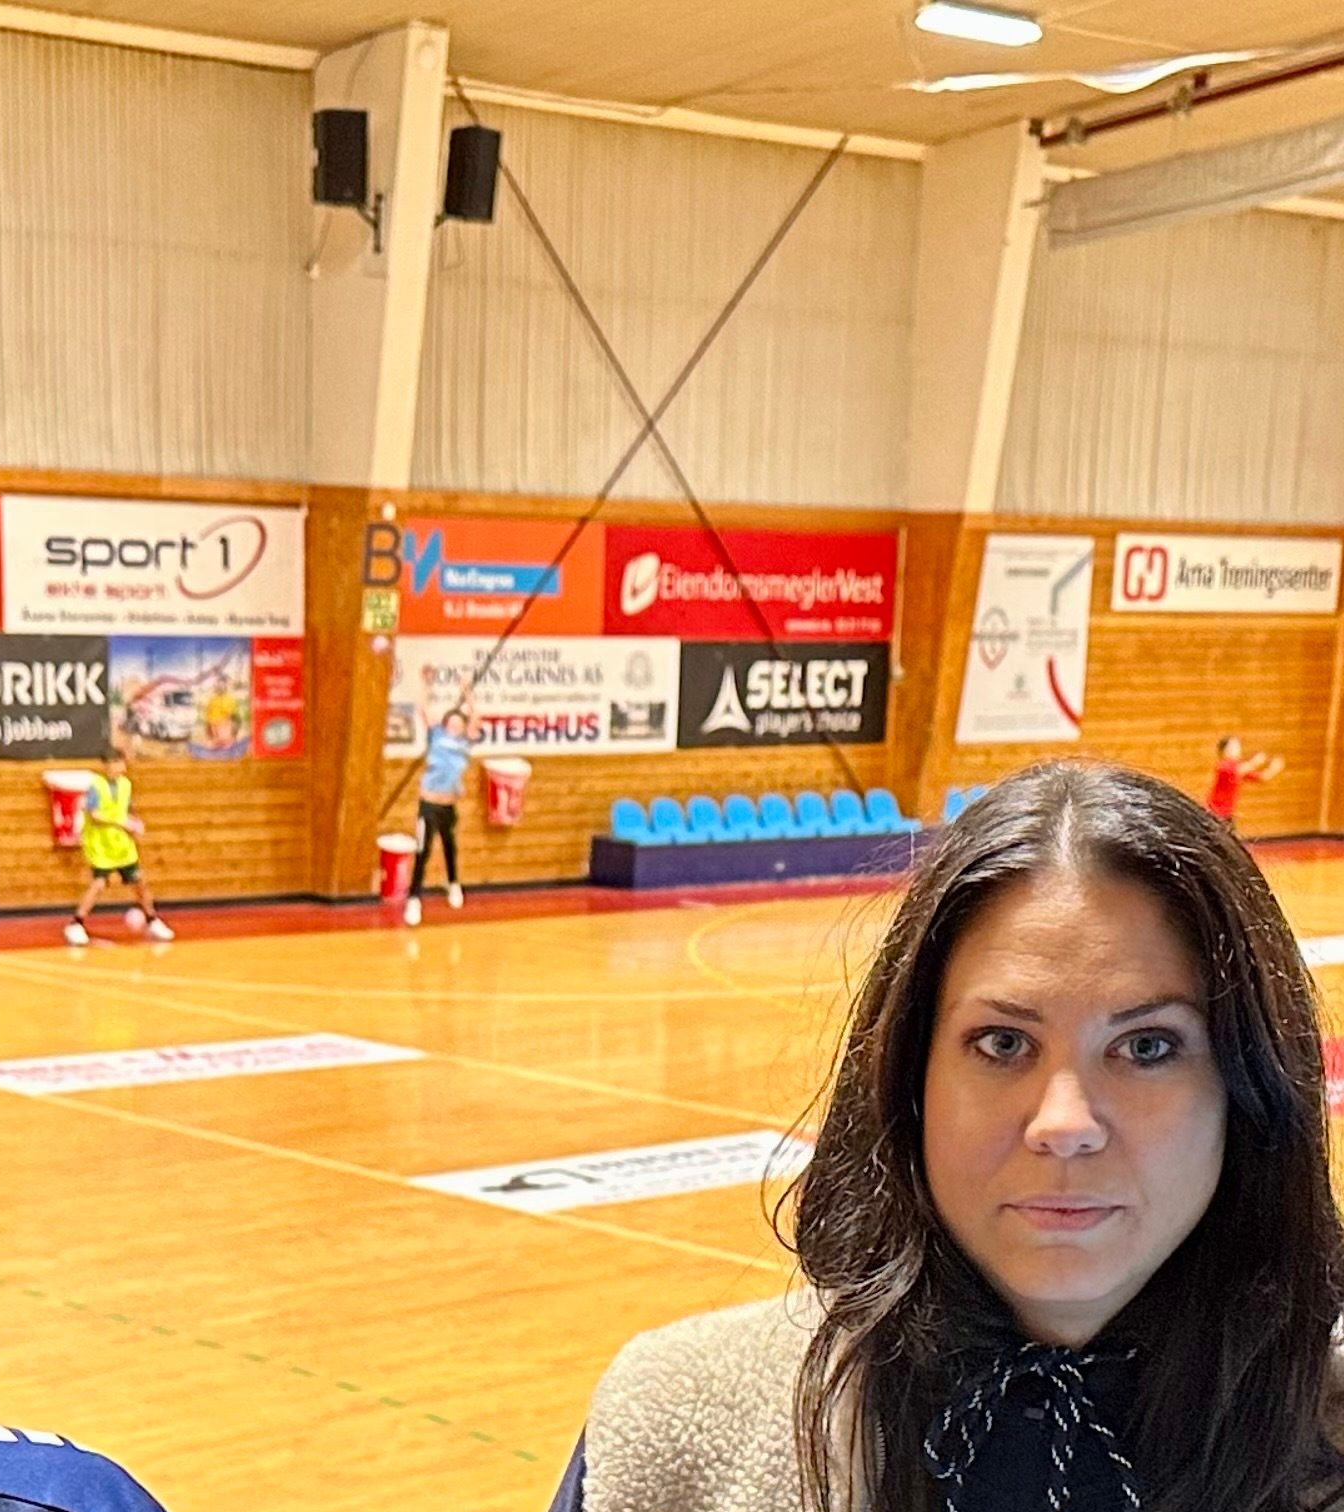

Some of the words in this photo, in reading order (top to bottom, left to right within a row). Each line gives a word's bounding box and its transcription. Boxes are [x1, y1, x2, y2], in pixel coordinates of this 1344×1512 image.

[46, 534, 197, 575] sport
[219, 535, 231, 573] 1
[746, 660, 869, 709] SELECT
